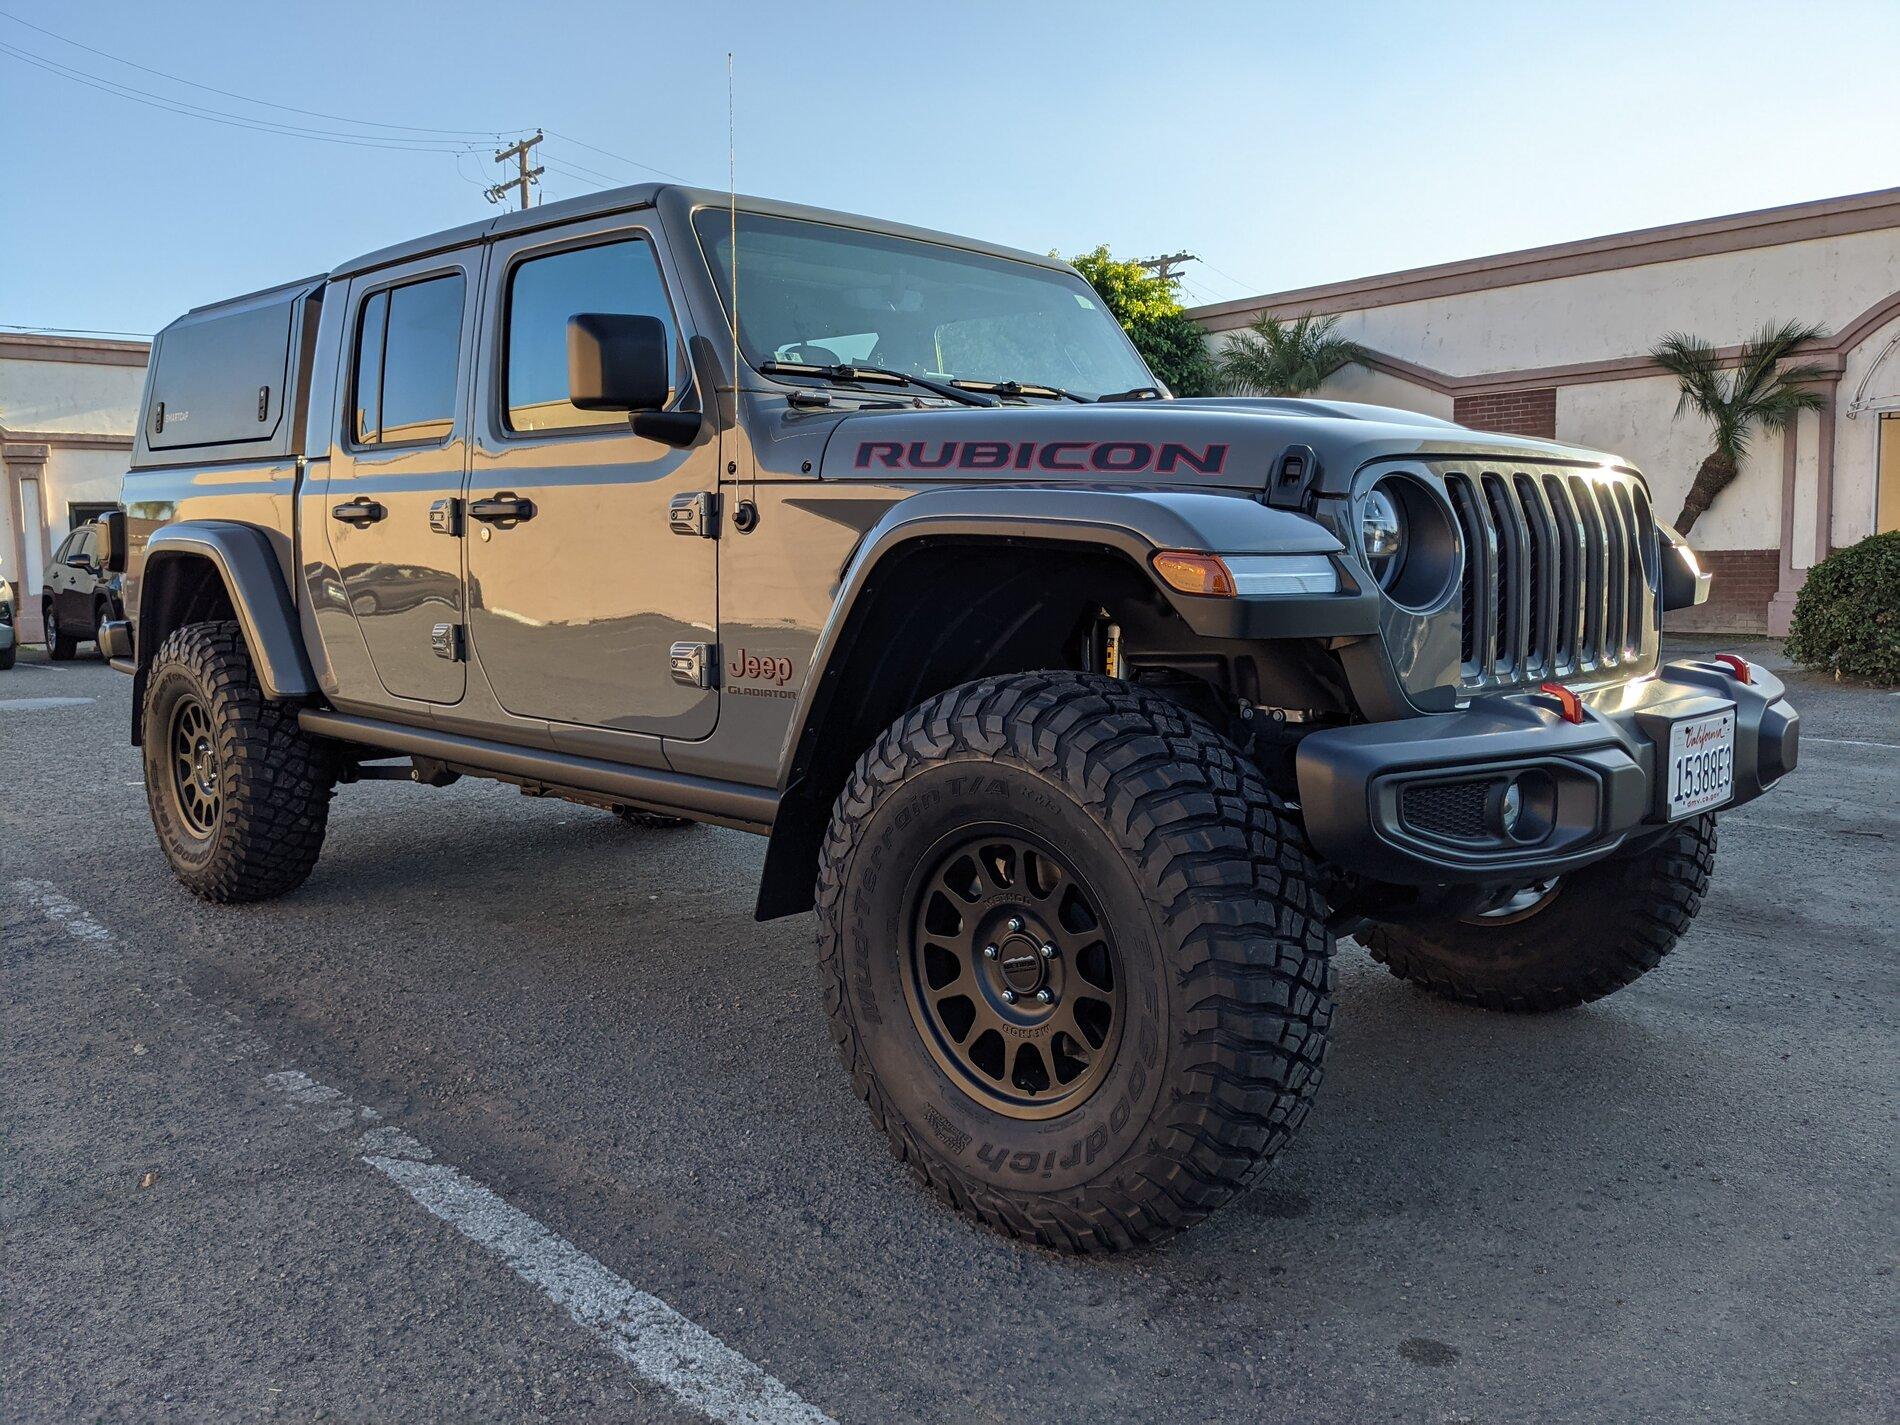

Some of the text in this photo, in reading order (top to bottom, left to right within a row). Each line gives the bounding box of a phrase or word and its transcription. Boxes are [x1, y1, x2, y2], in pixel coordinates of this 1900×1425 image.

[854, 441, 1230, 475] RUBICON
[729, 648, 793, 687] Jeep
[727, 685, 797, 700] GLADIATOR
[1685, 724, 1726, 751] California
[948, 775, 1010, 800] T/A
[1674, 745, 1731, 803] 15388E3
[1003, 1023, 1053, 1039] METHOD
